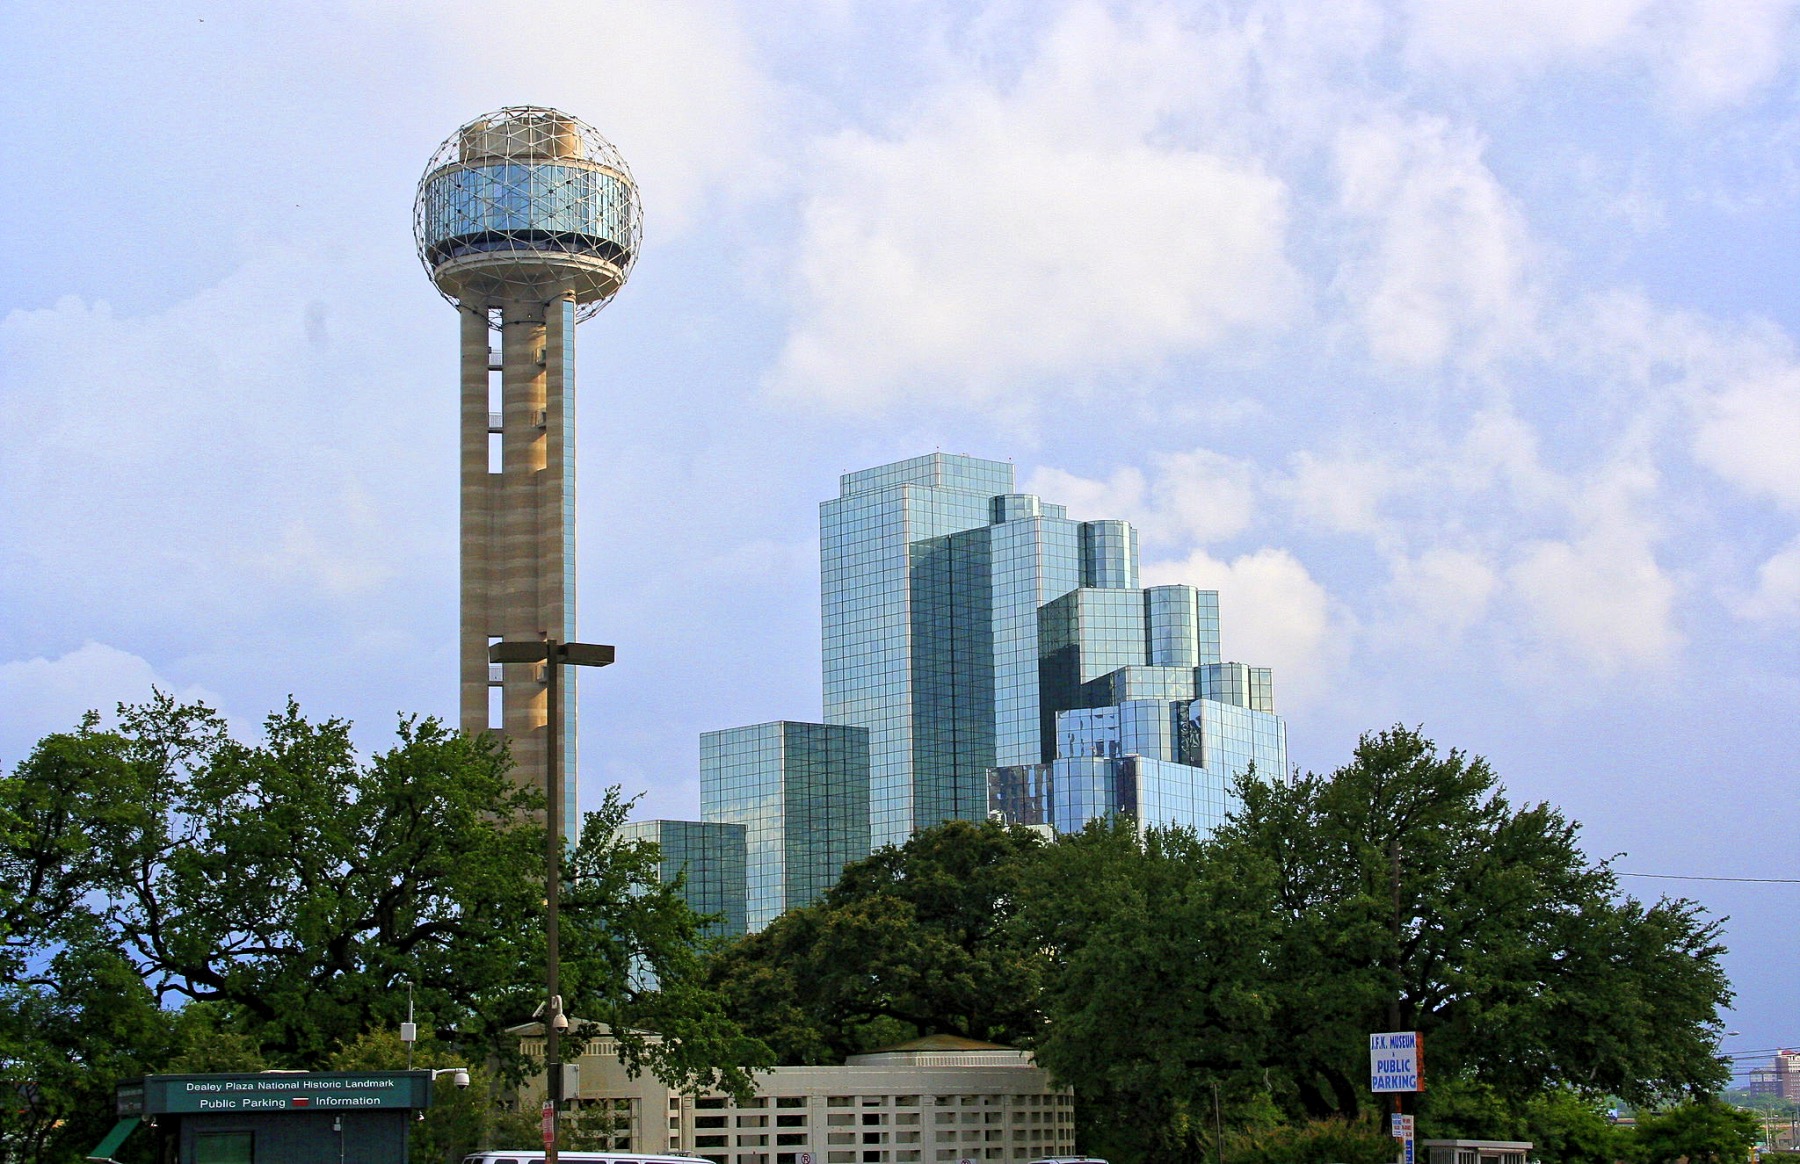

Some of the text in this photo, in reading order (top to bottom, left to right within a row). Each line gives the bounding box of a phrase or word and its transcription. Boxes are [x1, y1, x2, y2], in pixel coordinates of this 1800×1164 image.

[1390, 1034, 1415, 1049] MUSEUM
[1377, 1059, 1411, 1073] PUBLIC
[186, 1079, 394, 1092] Dealey Plaza National Historic Landmark
[1372, 1075, 1417, 1090] PARKING
[200, 1097, 381, 1109] Public Parking Information
